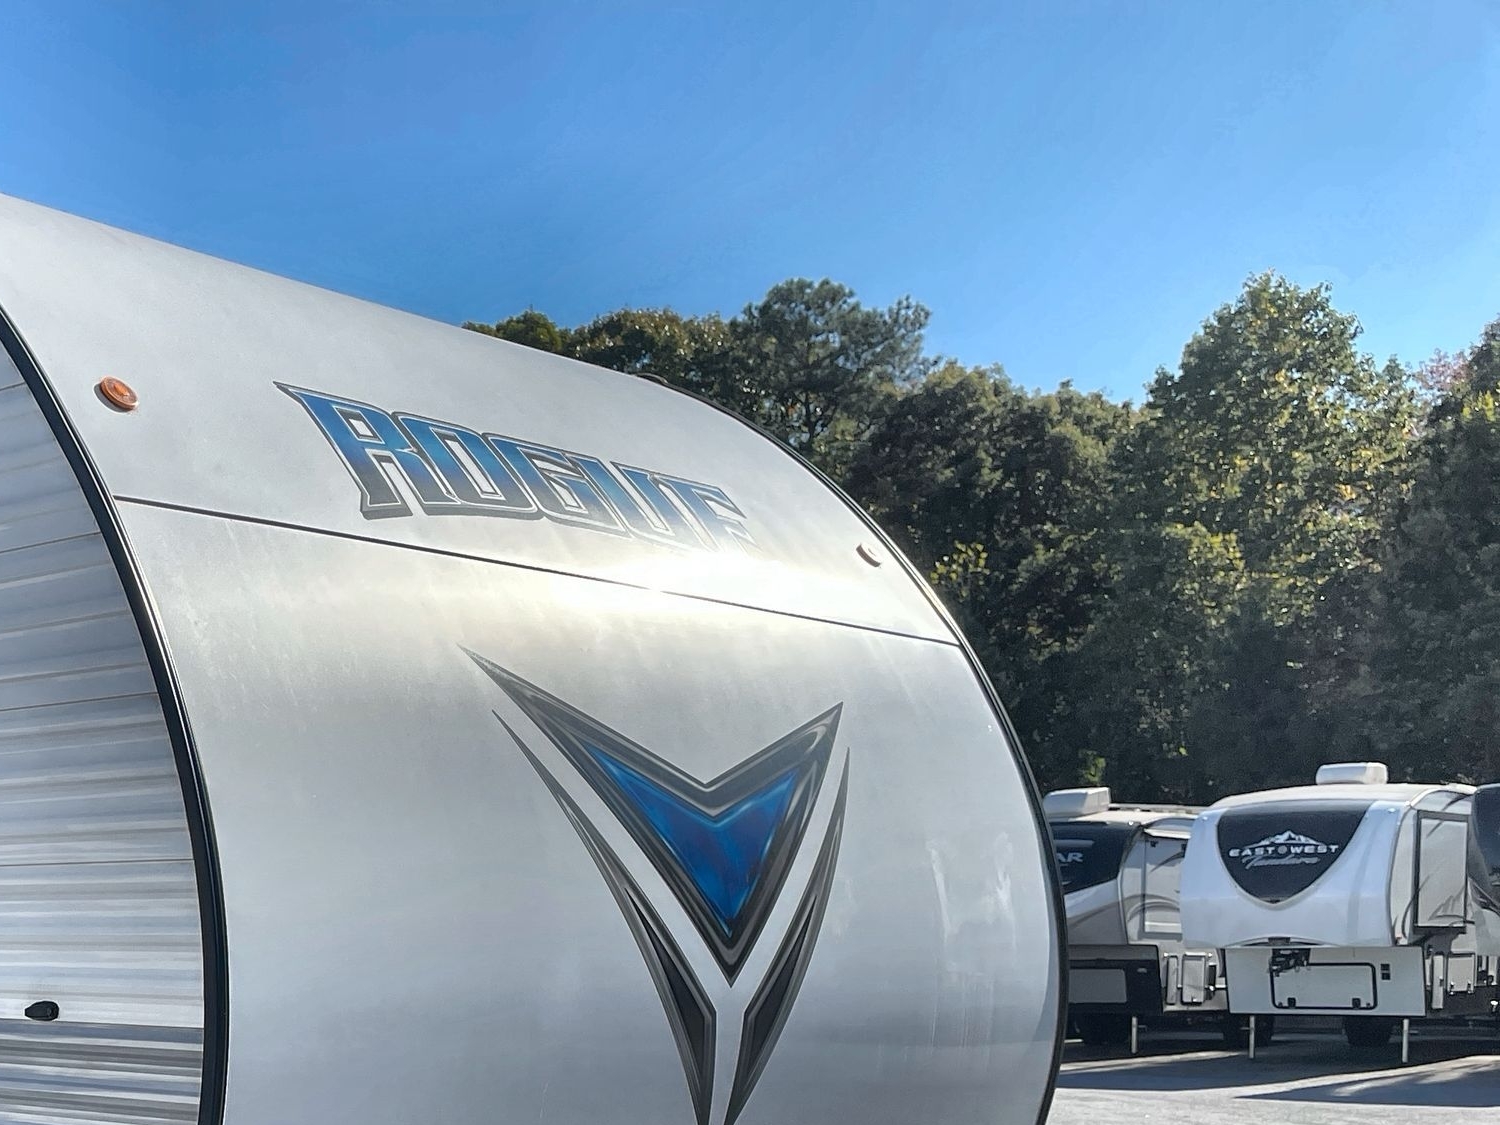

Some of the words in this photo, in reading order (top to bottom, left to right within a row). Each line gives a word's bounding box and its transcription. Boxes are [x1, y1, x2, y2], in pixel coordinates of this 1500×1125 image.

[272, 379, 764, 558] ROGUE
[1228, 846, 1275, 857] EAST
[1290, 844, 1339, 854] WEST
